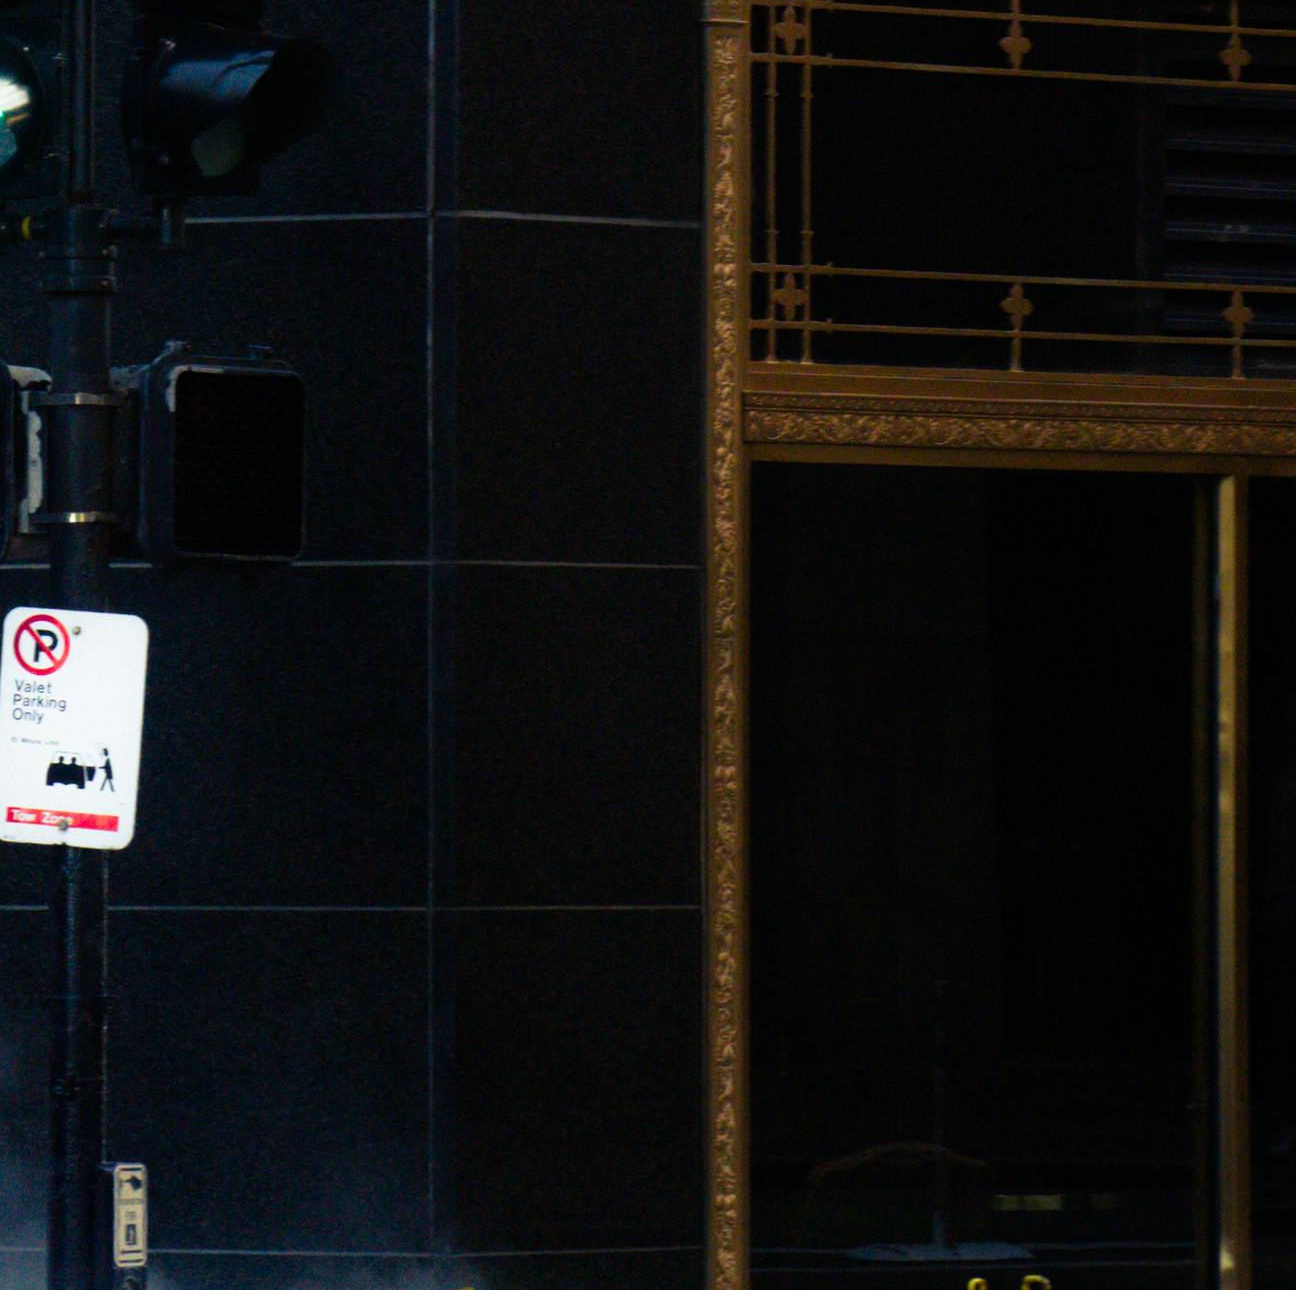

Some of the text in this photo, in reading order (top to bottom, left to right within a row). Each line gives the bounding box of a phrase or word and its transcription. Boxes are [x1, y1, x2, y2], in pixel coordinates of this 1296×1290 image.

[34, 629, 59, 662] P
[14, 679, 52, 694] Valet
[13, 693, 67, 712] Parking
[12, 707, 44, 724] Only
[11, 809, 36, 822] Tow
